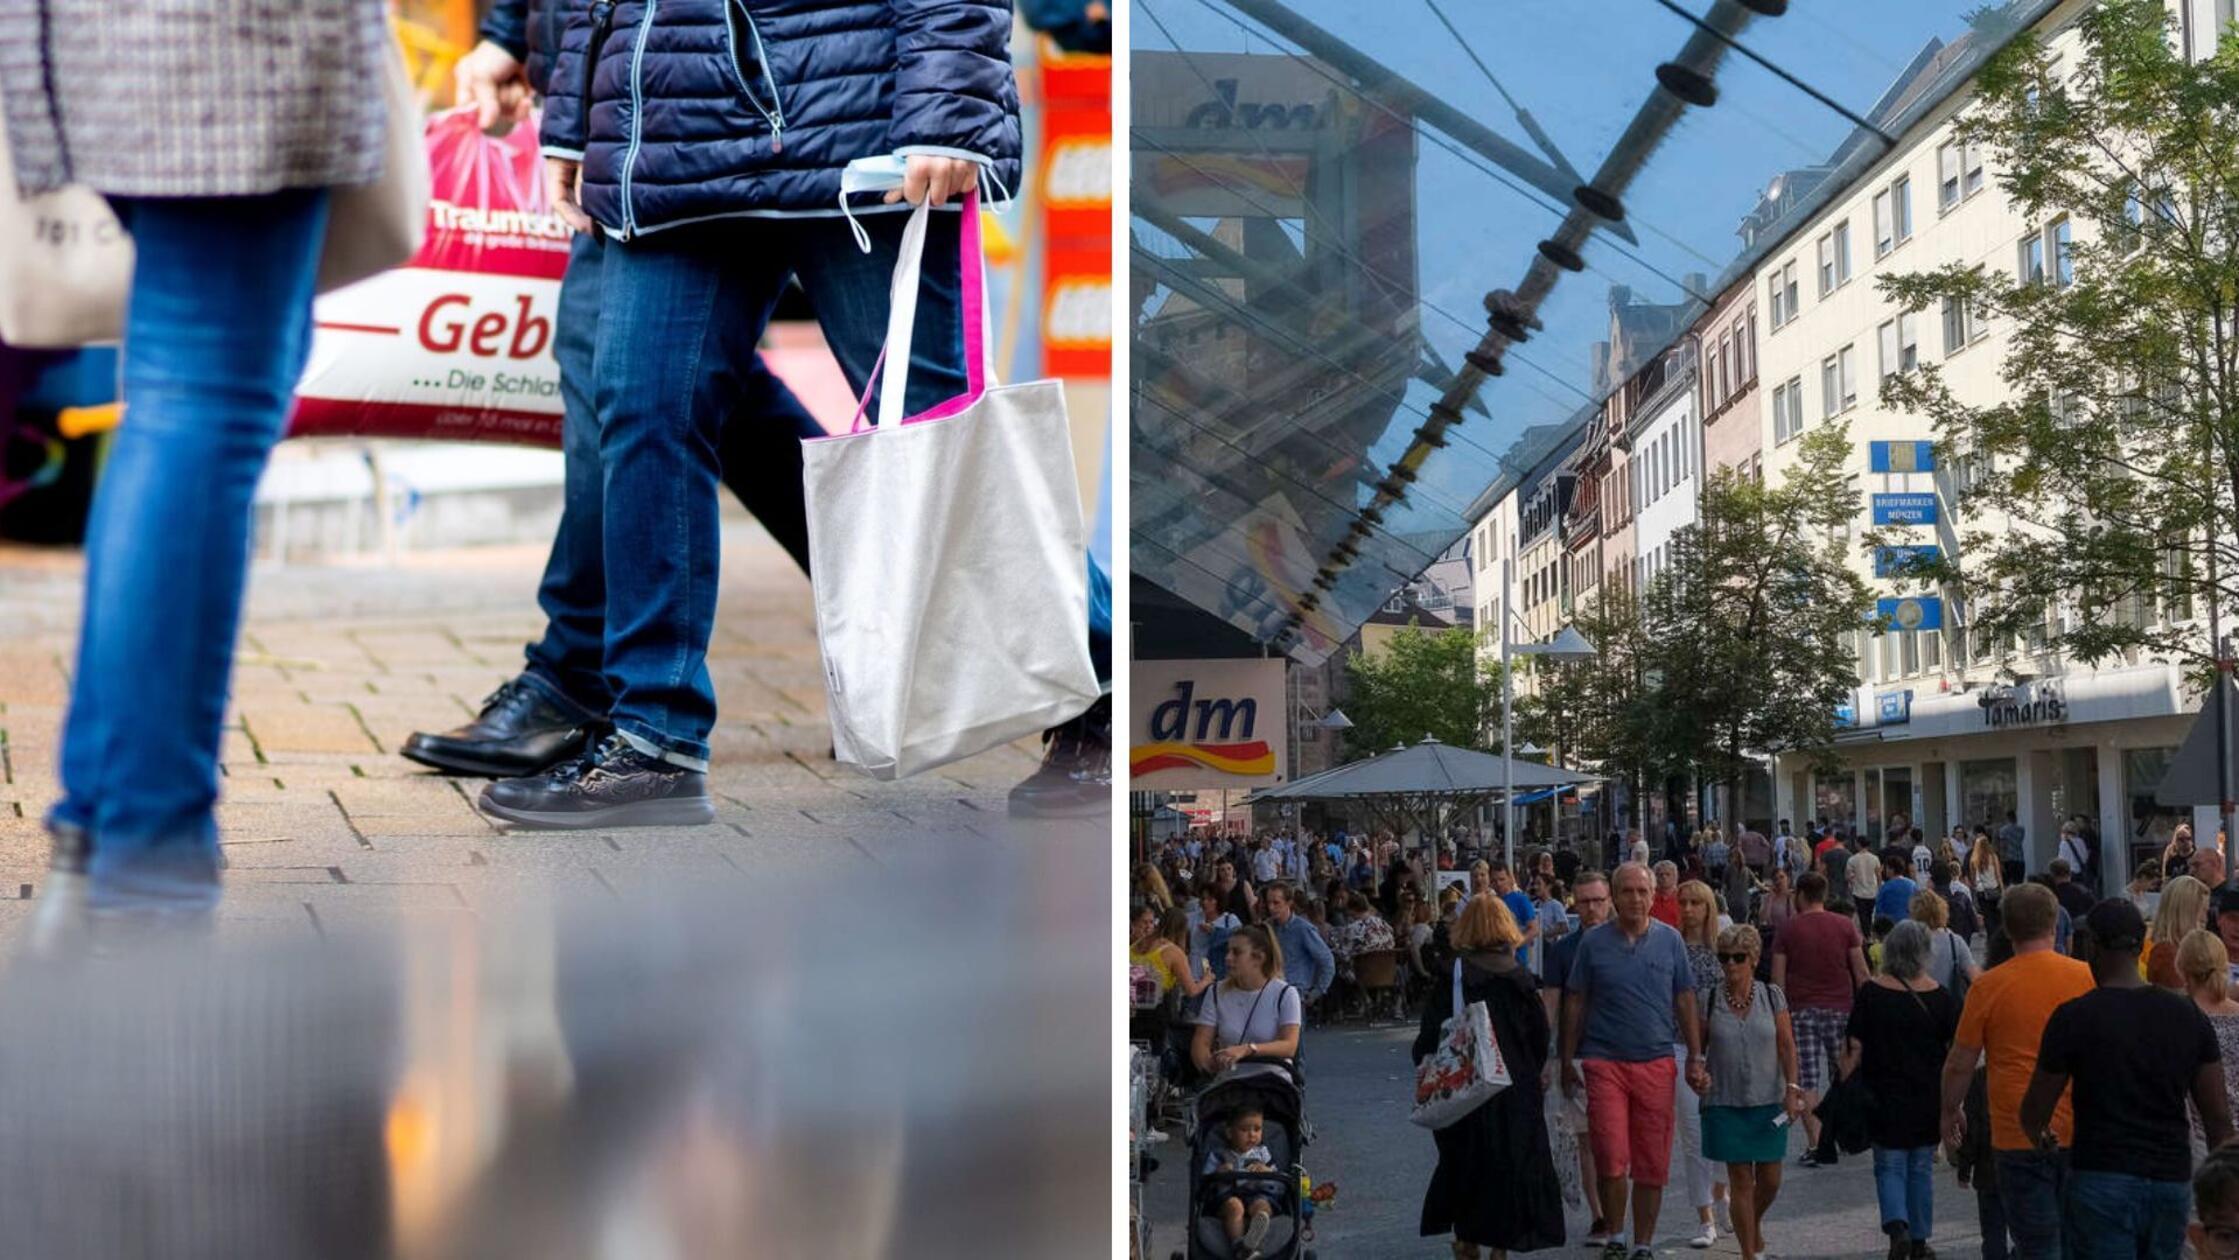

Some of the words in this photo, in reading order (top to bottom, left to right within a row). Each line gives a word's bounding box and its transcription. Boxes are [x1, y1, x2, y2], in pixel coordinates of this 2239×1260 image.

[417, 294, 557, 360] Geb
[1151, 680, 1257, 740] dm
[1979, 689, 2062, 726] Tamaris
